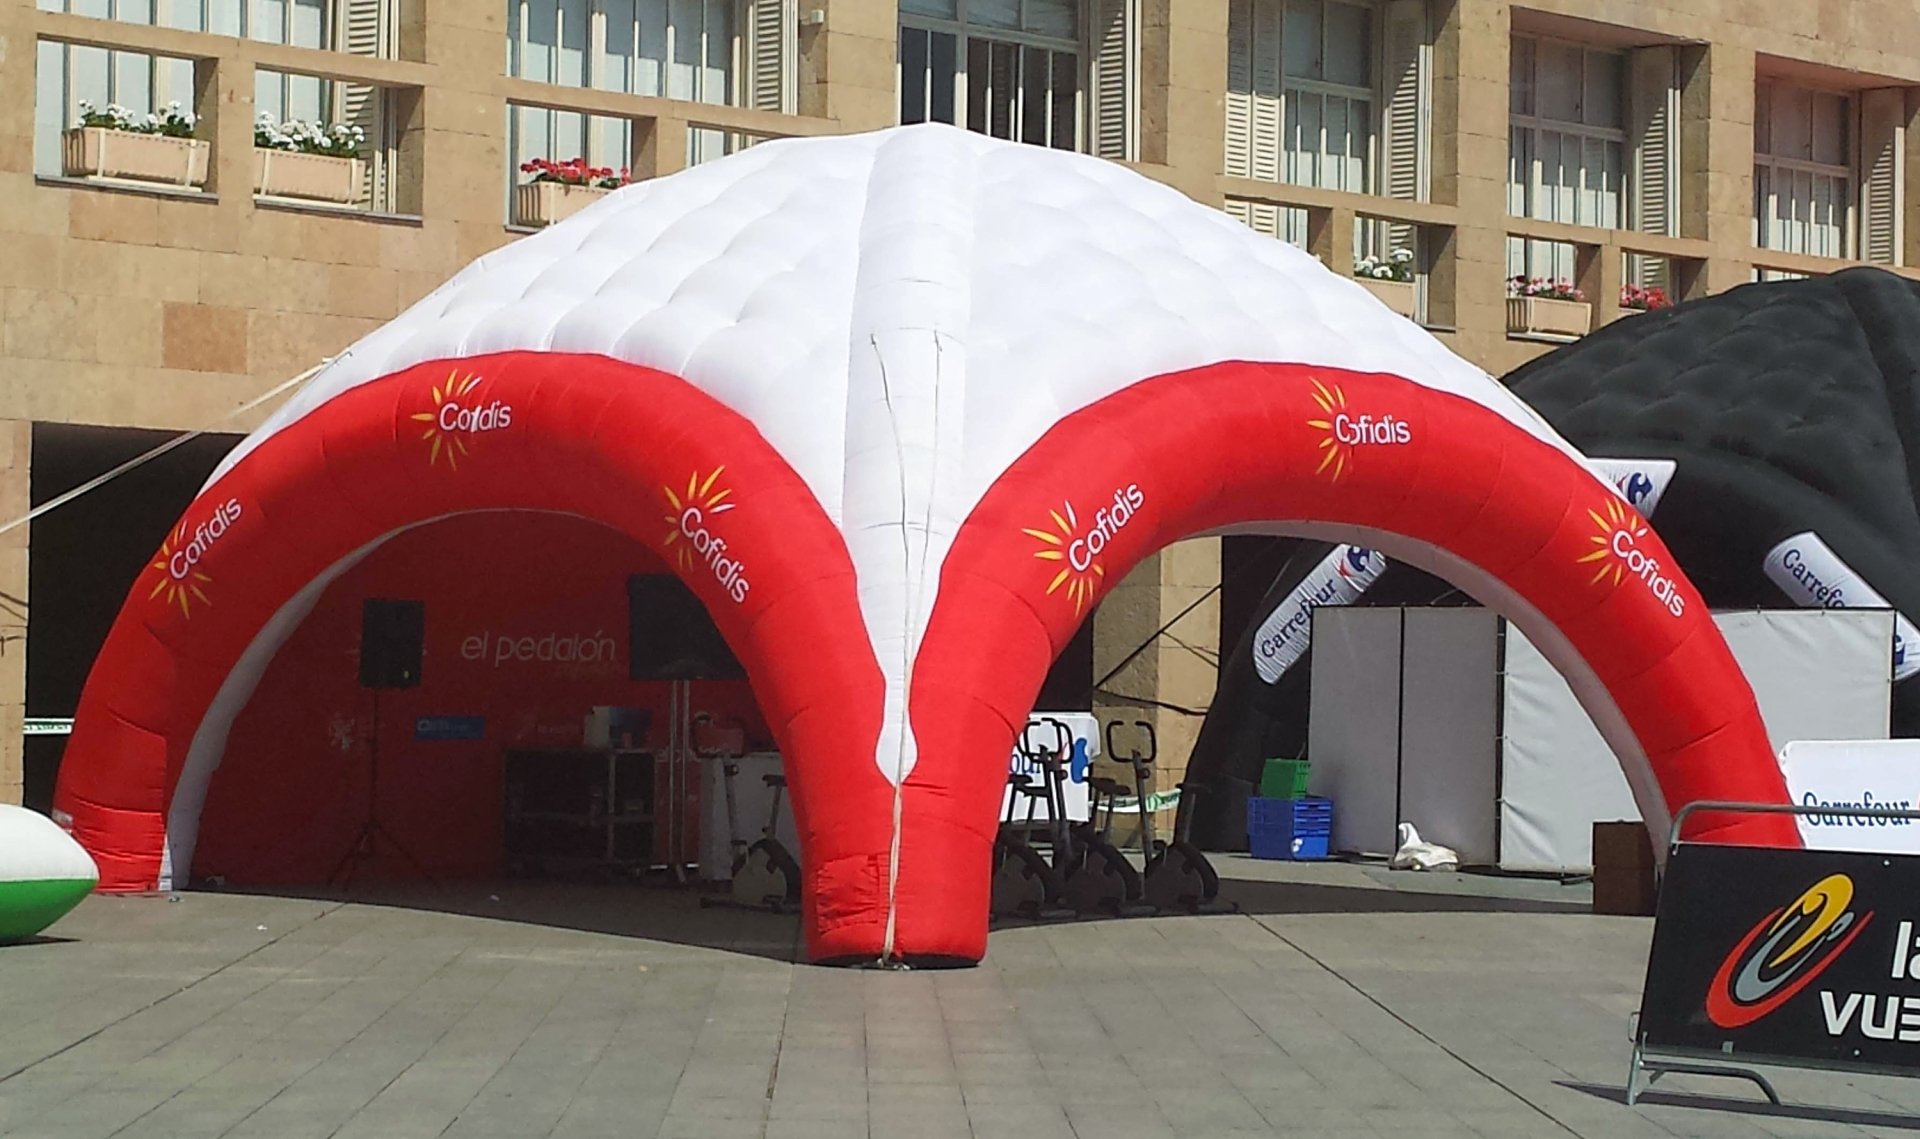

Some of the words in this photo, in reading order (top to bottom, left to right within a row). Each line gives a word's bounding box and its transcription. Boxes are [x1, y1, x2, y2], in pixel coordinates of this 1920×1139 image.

[170, 498, 242, 579] Cofidis
[681, 507, 750, 603] Cofidis
[1069, 484, 1144, 572] Cofidis
[1612, 530, 1685, 617] Cofidis
[461, 630, 489, 660] el
[494, 629, 616, 669] pedalón
[1803, 791, 1911, 826] Carrefour
